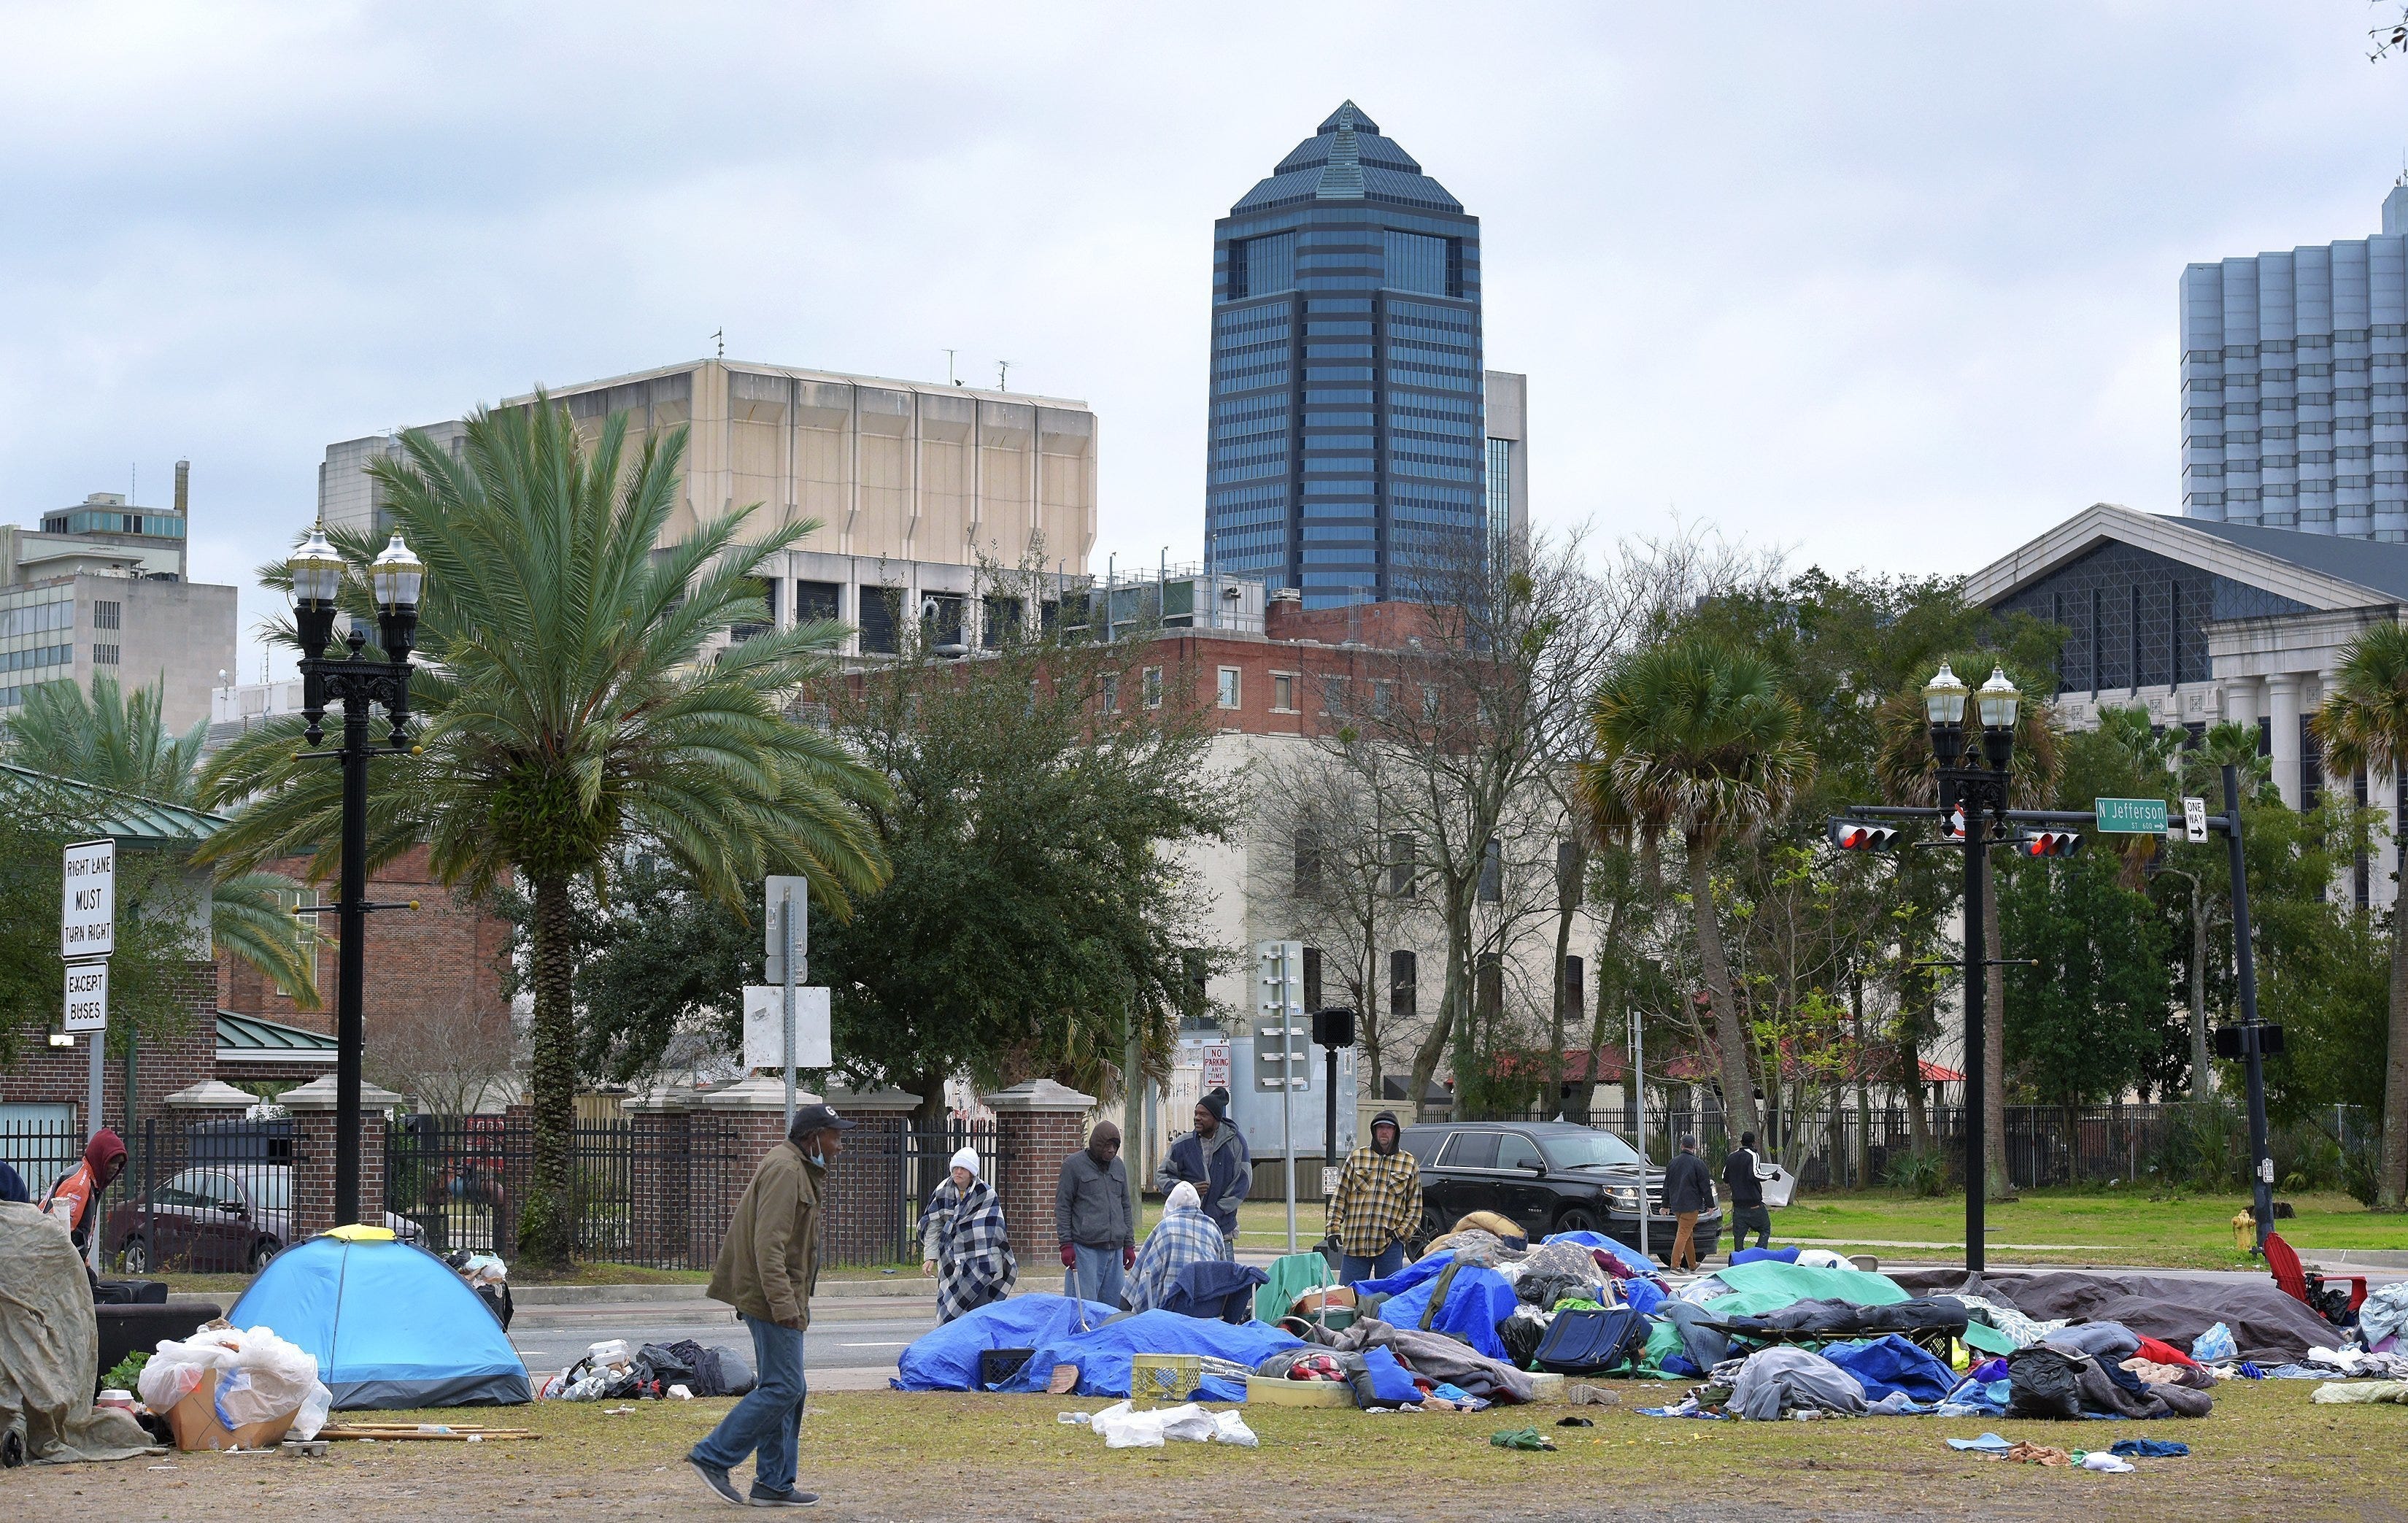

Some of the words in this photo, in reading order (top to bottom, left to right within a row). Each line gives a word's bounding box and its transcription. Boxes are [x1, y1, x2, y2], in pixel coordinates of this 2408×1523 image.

[2099, 801, 2106, 818] N
[2112, 802, 2164, 820] Jefferson
[2187, 801, 2203, 812] ONE
[2142, 822, 2153, 830] 600
[2188, 814, 2204, 825] WAY
[67, 858, 89, 877] RIGHT
[92, 856, 111, 874] LANE
[75, 888, 101, 911] MUST
[65, 925, 85, 944] TURN
[88, 922, 111, 941] RIGHT
[69, 973, 103, 993] EXCEPT
[71, 1001, 101, 1020] BUSES
[1205, 1058, 1229, 1067] PARKING
[1211, 1049, 1222, 1057] NO
